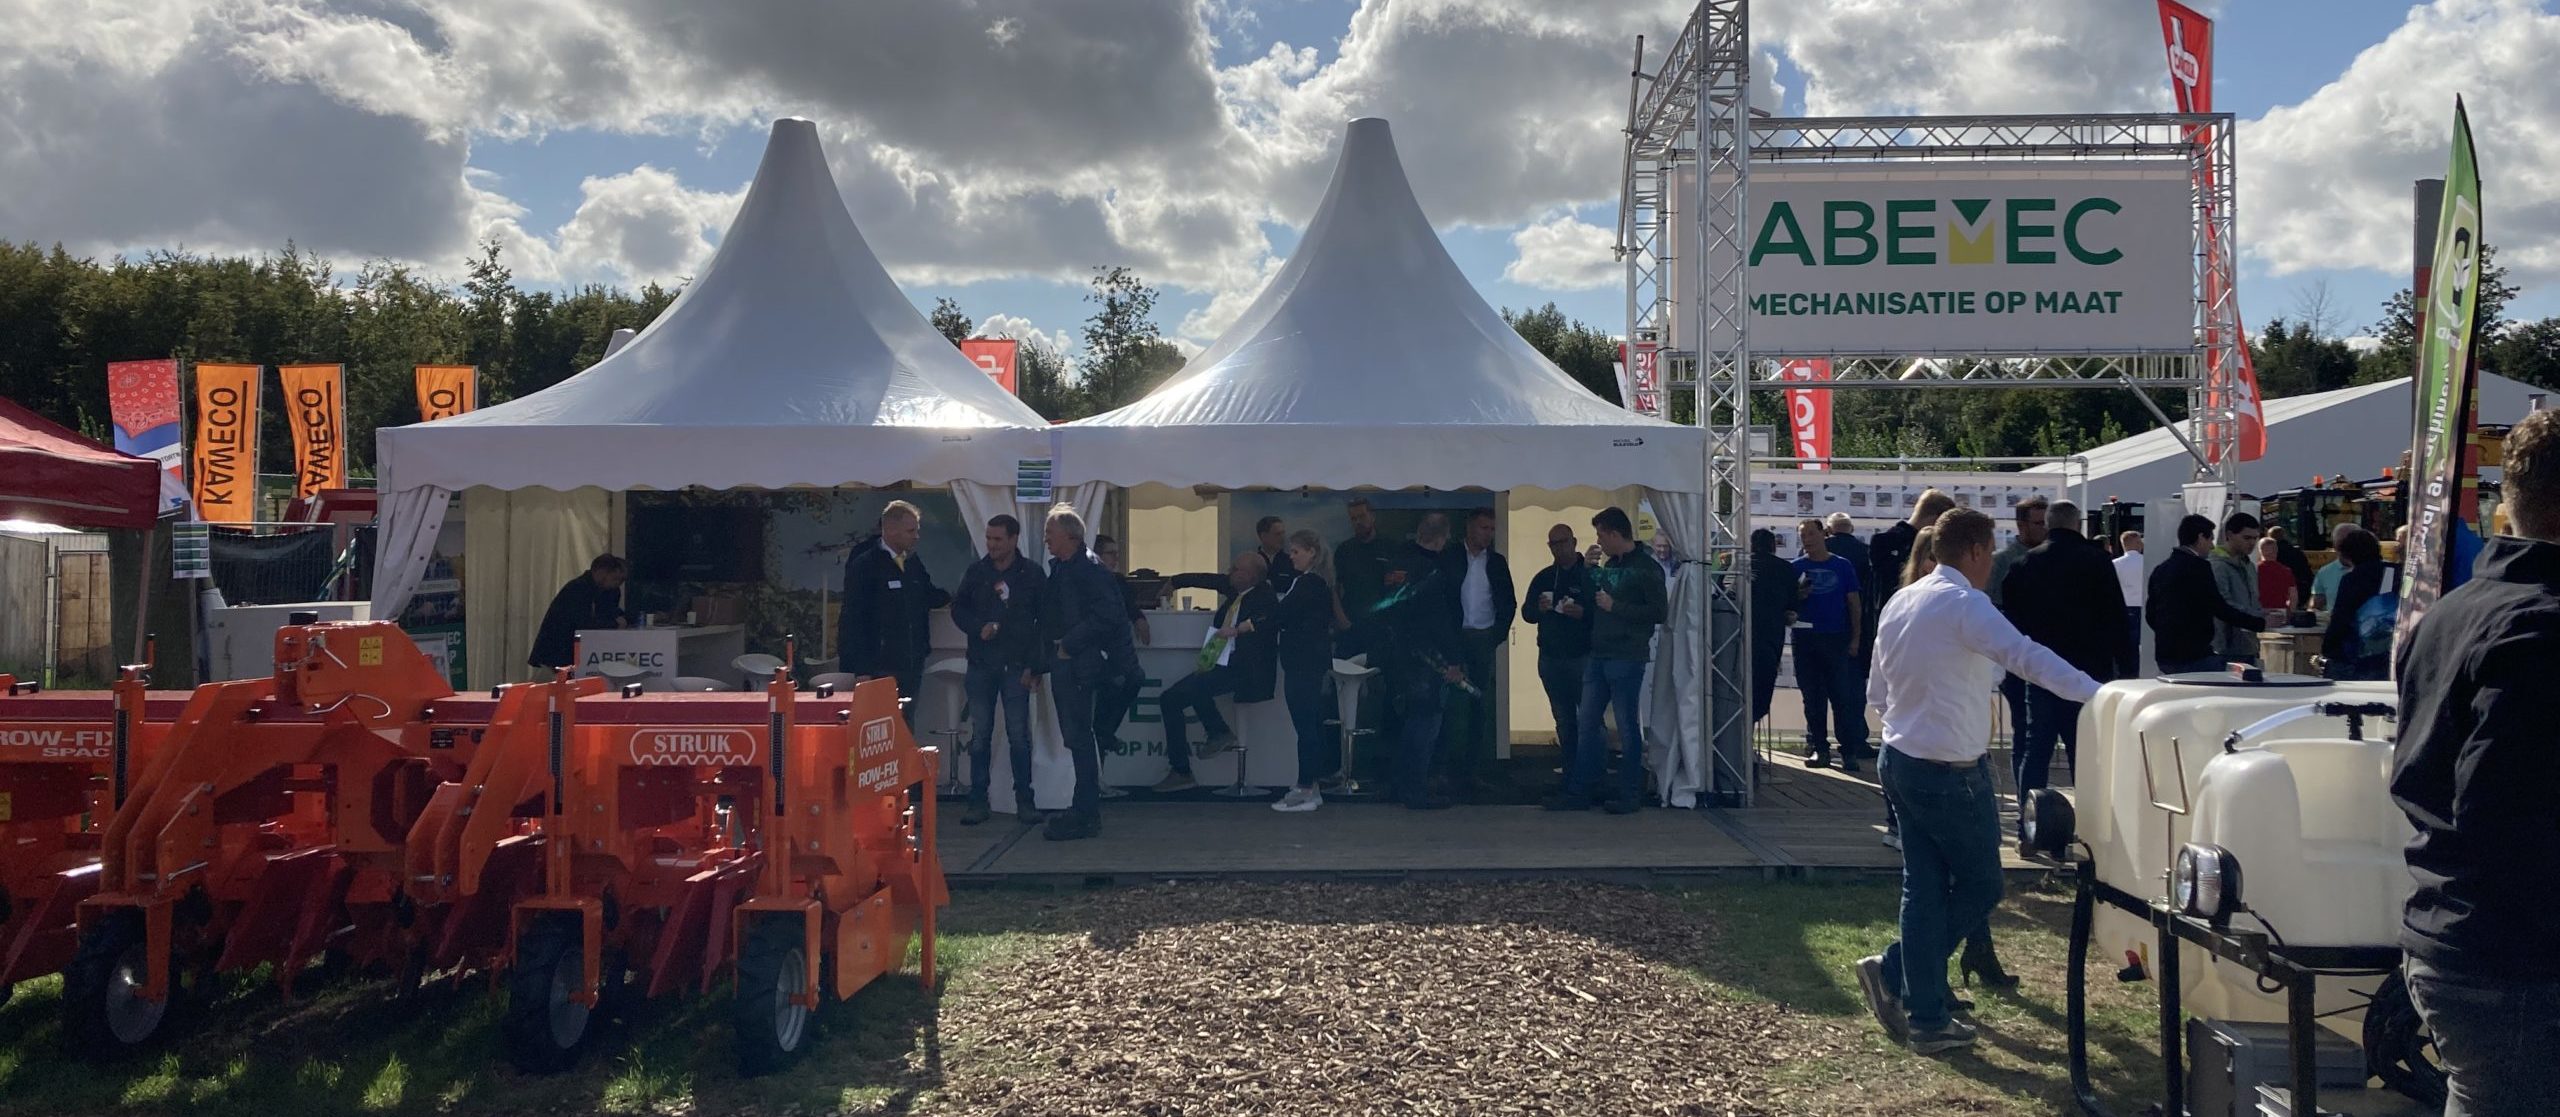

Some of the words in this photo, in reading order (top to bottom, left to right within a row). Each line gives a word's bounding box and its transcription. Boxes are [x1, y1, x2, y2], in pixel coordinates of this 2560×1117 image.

[1748, 197, 2124, 267] ABEMEC
[1748, 291, 1976, 316] MECHANISATIE
[1985, 291, 2026, 314] OP
[2035, 291, 2123, 314] MAAT
[654, 734, 731, 753] STRUIK
[866, 722, 888, 745] STRUIK
[42, 747, 111, 757] SPAC
[858, 759, 899, 789] ROW-FIX
[873, 775, 899, 792] SPACE
